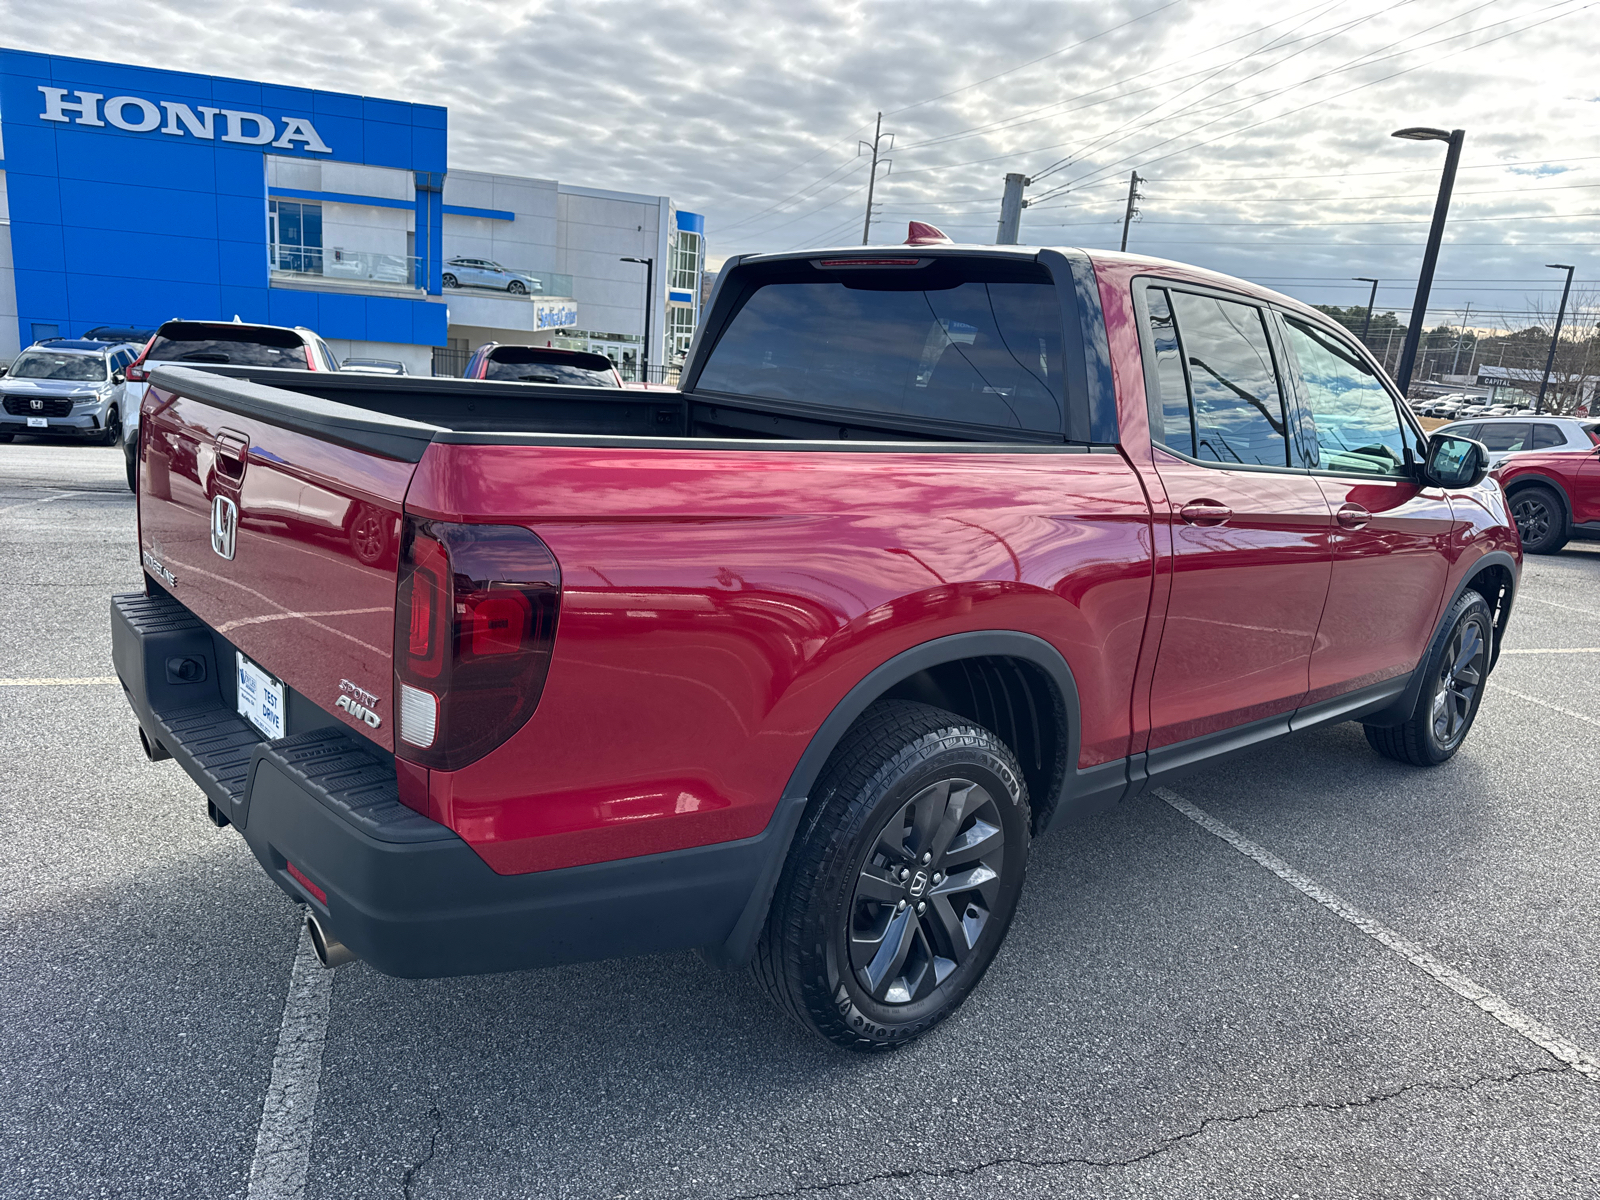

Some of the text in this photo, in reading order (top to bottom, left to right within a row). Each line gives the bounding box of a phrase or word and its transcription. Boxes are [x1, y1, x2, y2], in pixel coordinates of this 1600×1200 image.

[37, 85, 332, 154] HONDA
[1484, 378, 1510, 386] CAPITAL
[263, 687, 278, 709] TEST
[338, 678, 381, 708] SPORT
[262, 703, 280, 729] DRIVE
[334, 694, 382, 729] AWD
